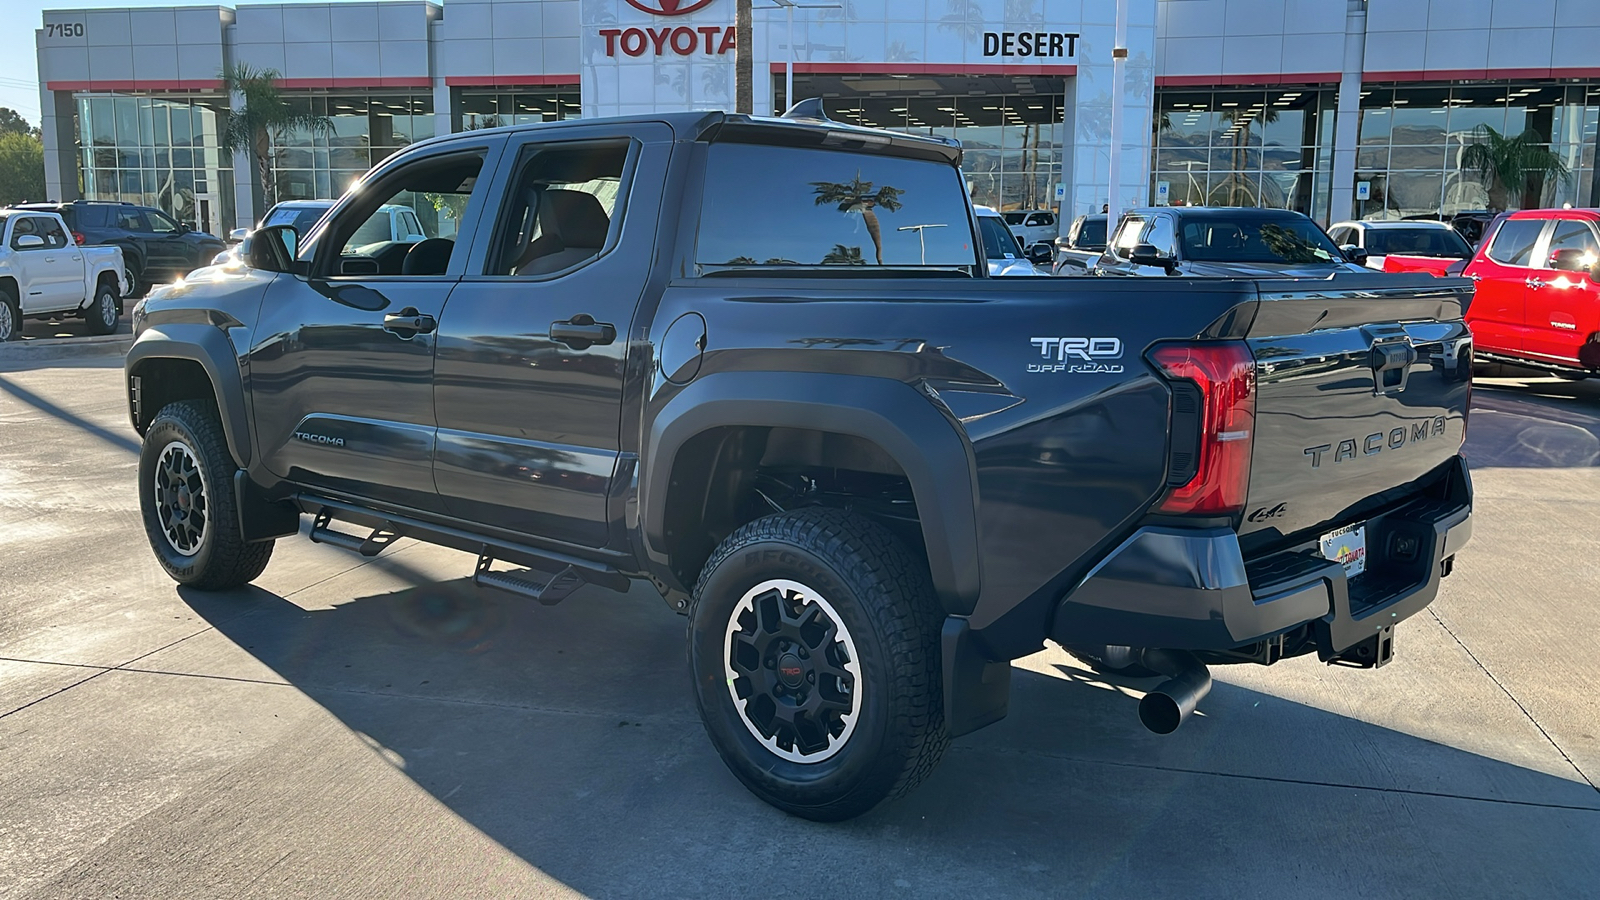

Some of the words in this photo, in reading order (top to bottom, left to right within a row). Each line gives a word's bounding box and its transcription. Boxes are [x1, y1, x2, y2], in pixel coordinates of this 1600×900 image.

[46, 23, 84, 37] 7150
[599, 26, 737, 57] TOYOTA
[983, 32, 1080, 57] DESERT
[1030, 337, 1124, 364] TRD
[1026, 363, 1065, 373] OFF
[1067, 363, 1125, 373] ROAD
[295, 431, 344, 447] TACOMA
[1303, 415, 1446, 468] TACOMA
[781, 667, 801, 676] TRD
